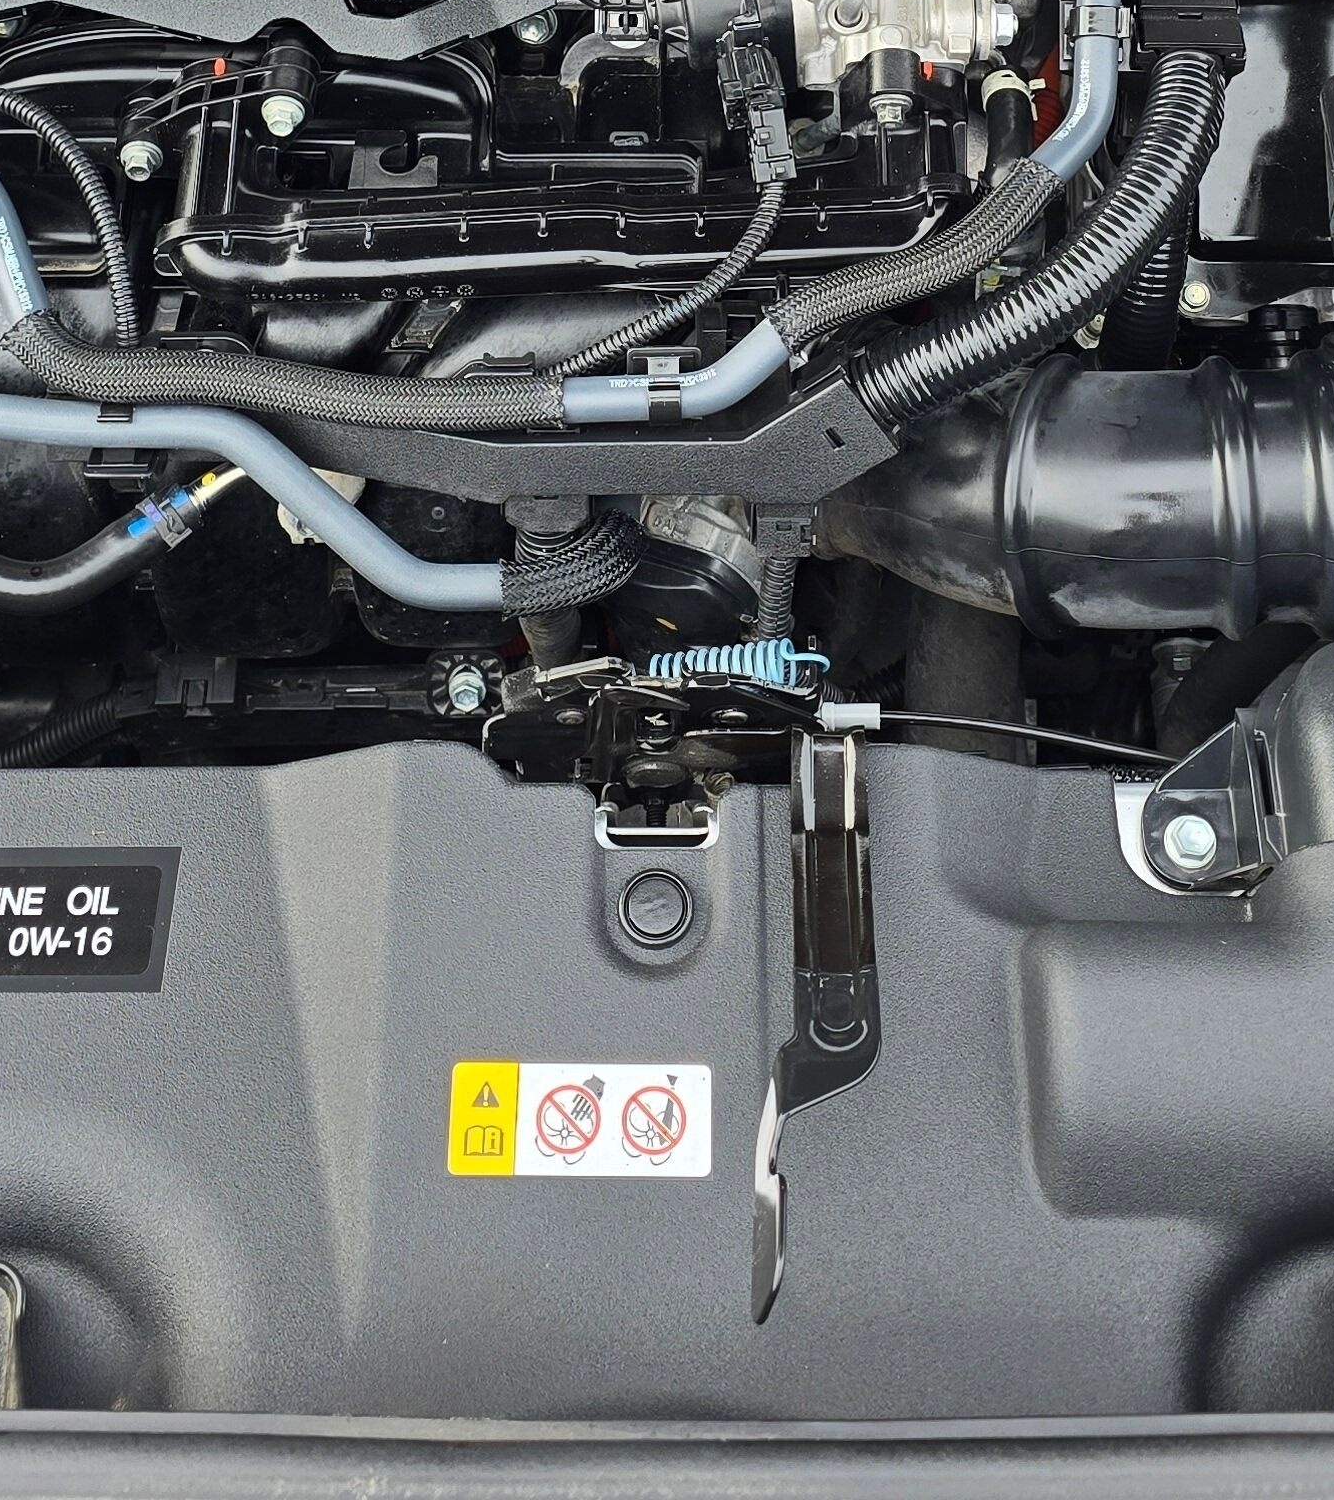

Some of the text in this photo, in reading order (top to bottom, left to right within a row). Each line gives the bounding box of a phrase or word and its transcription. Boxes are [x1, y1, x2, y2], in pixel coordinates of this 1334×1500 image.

[609, 378, 628, 388] TRD
[66, 886, 120, 916] OIL
[7, 926, 114, 957] 0W-16
